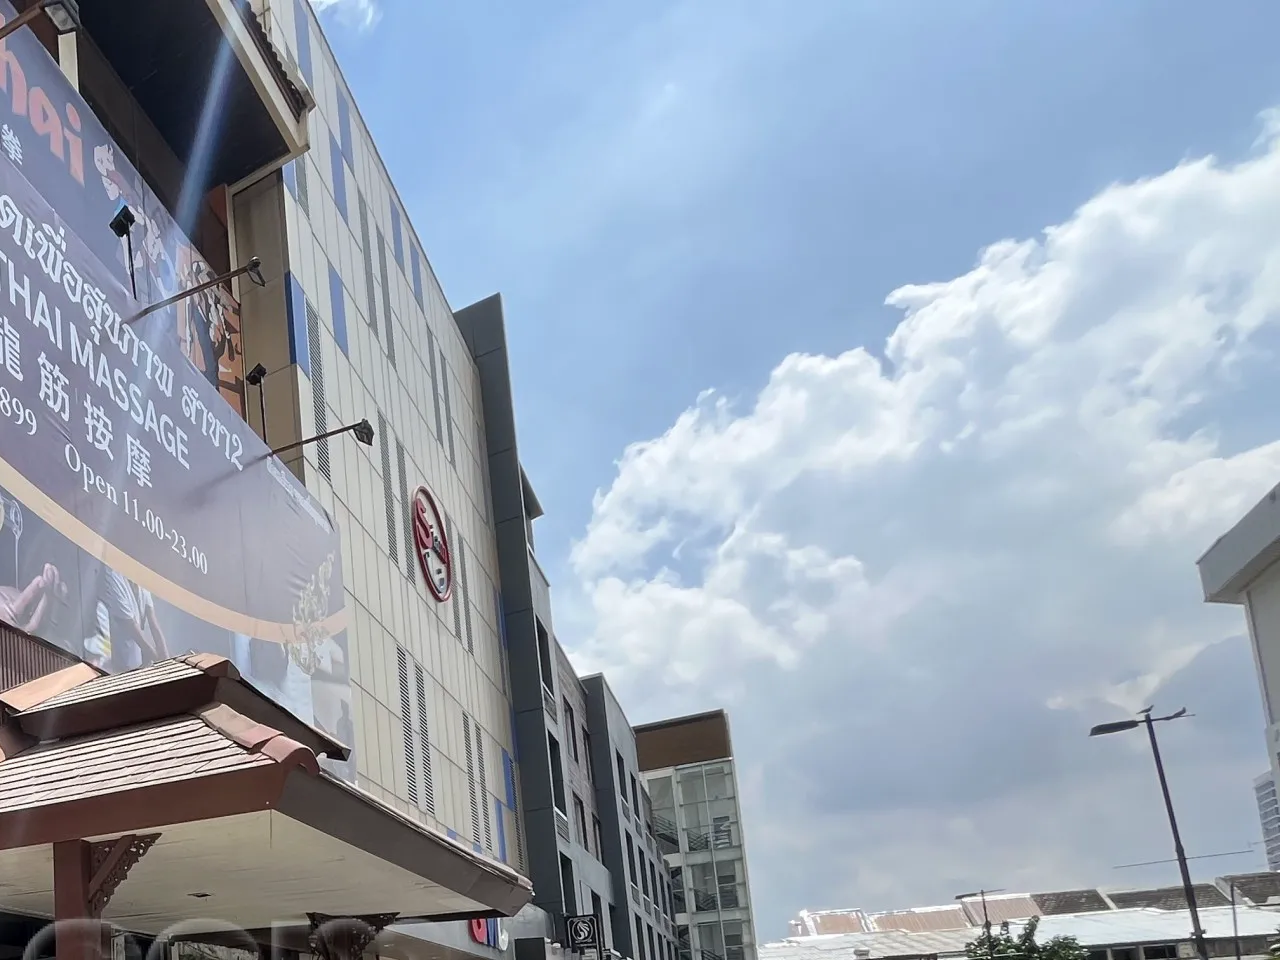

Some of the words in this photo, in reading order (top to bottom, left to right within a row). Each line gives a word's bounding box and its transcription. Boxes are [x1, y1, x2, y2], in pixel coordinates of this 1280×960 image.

[70, 322, 190, 470] MASSAGE
[64, 443, 118, 506] Open
[123, 491, 207, 575] 11.00-23.00
